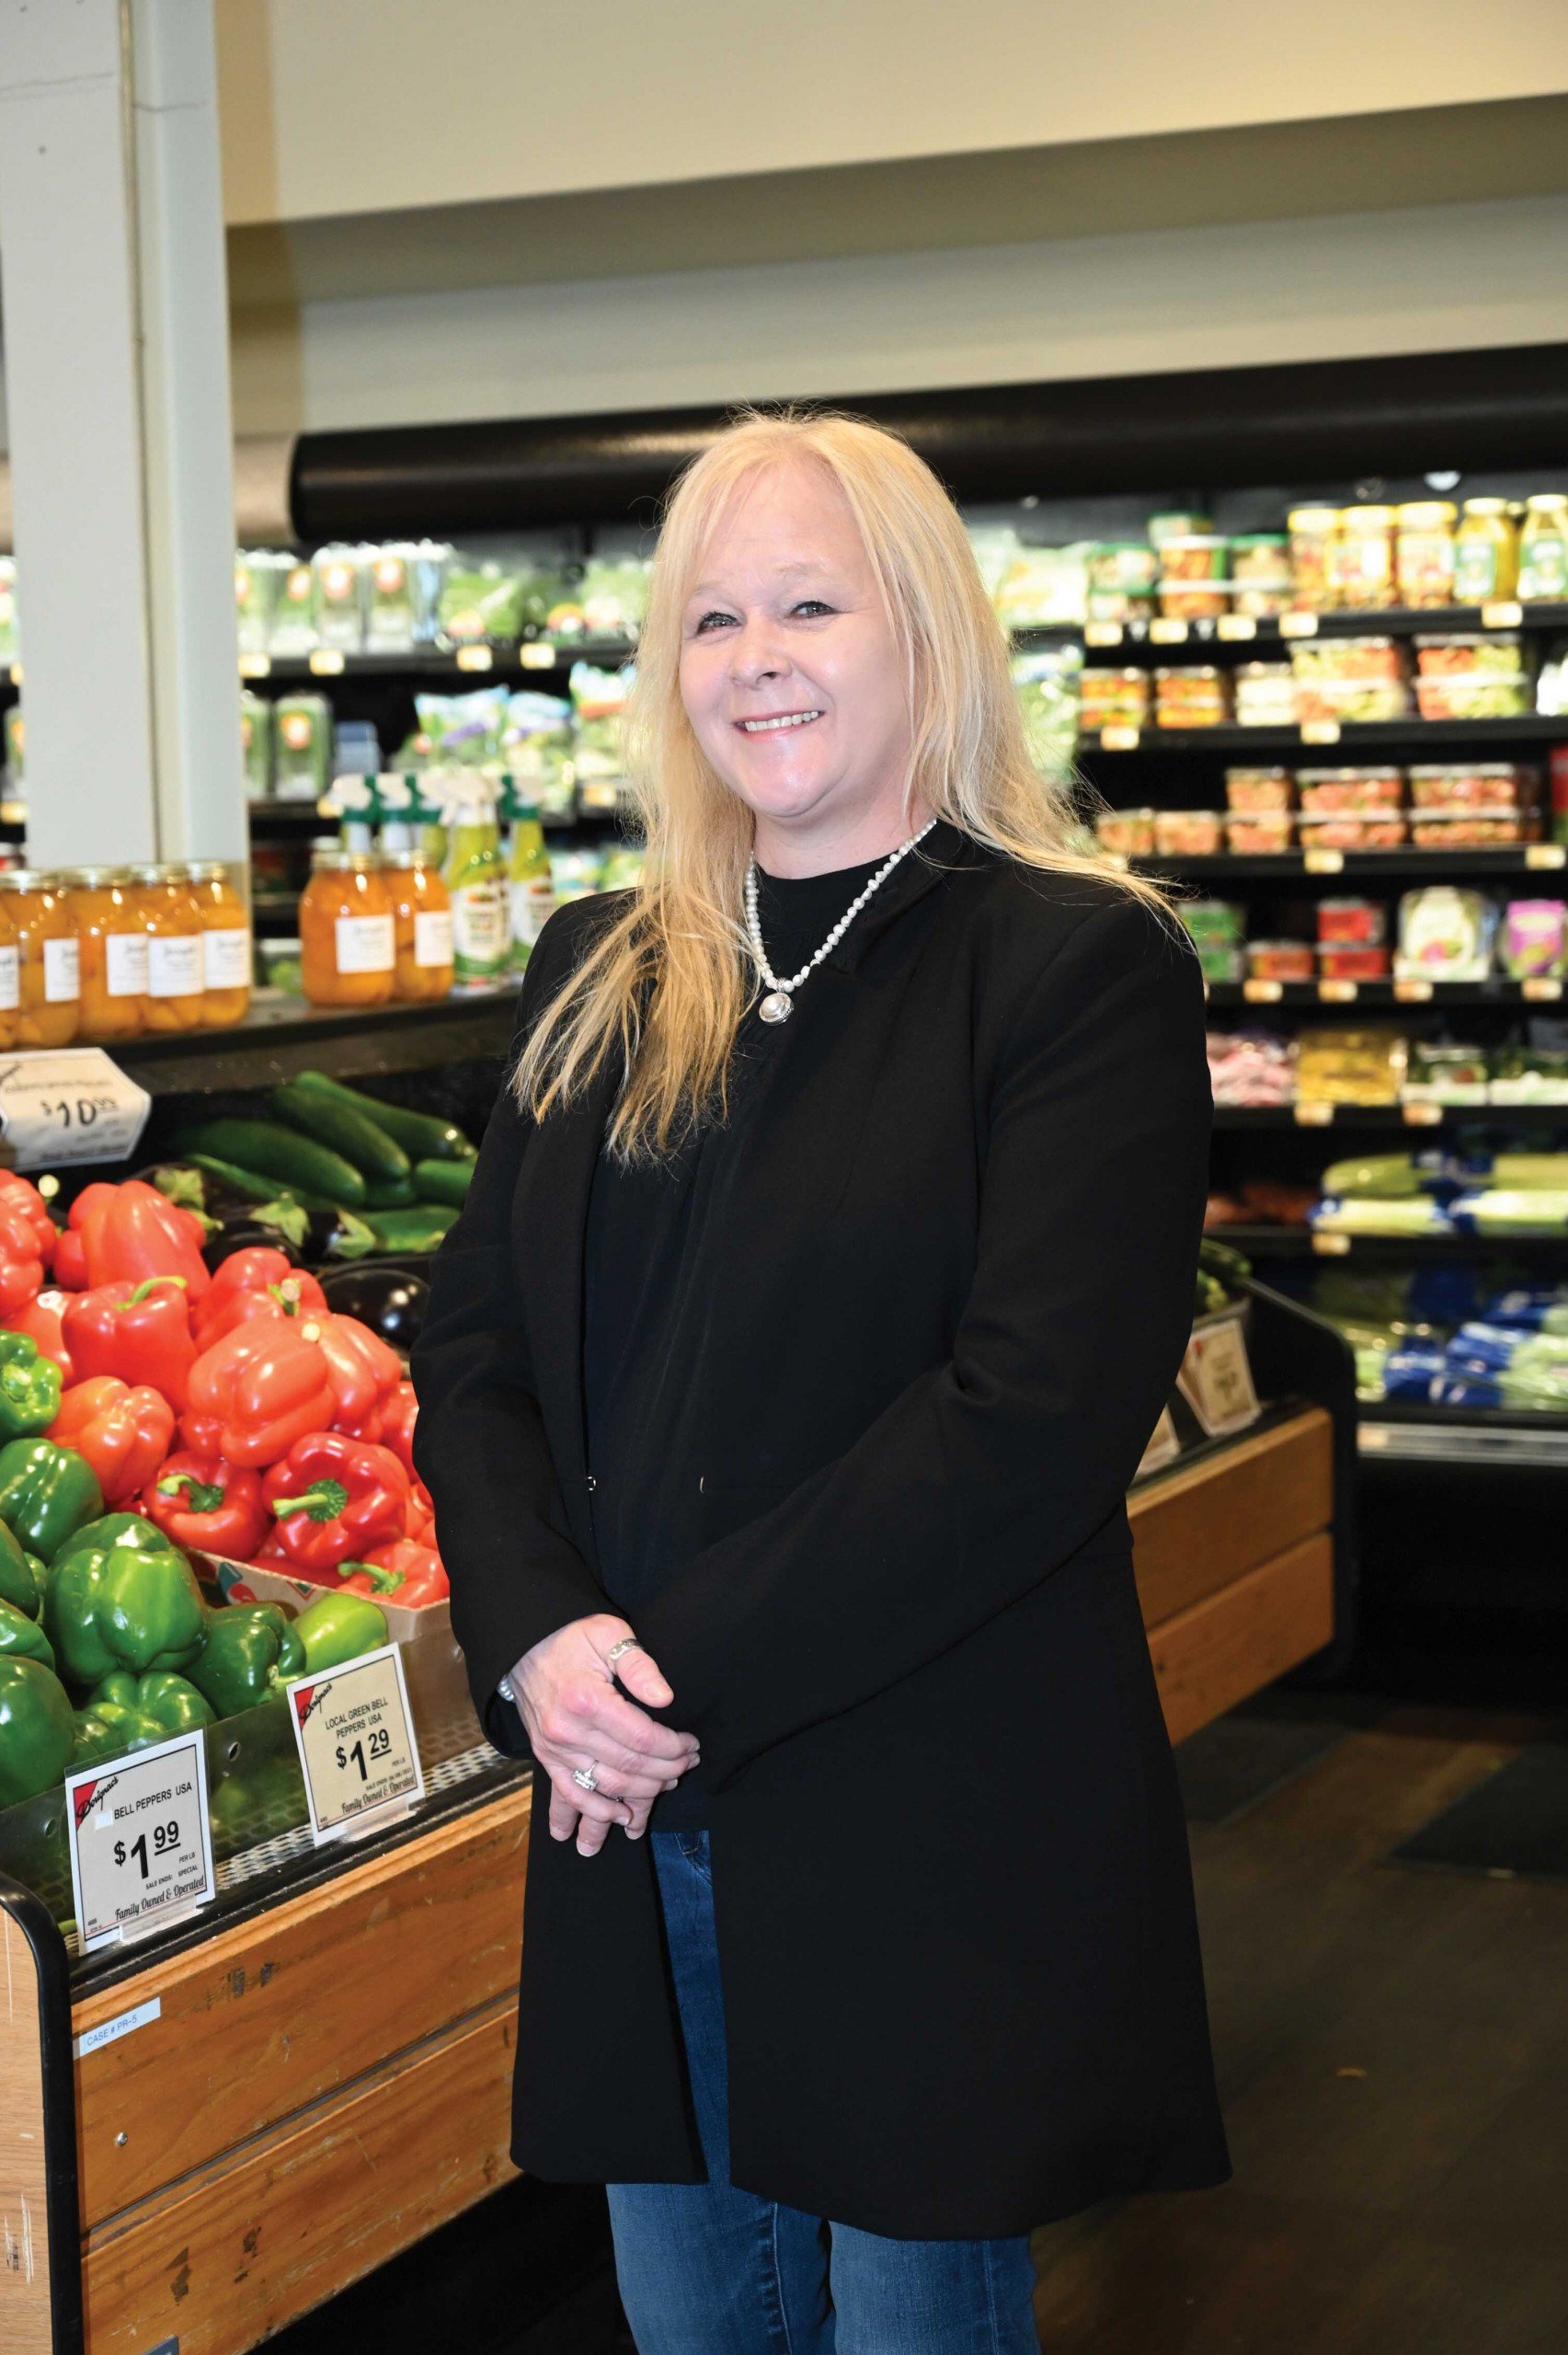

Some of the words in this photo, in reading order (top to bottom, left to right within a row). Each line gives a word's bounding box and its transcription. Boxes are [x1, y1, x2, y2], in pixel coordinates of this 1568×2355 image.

[325, 1714, 348, 1729] LOCAL
[349, 1704, 371, 1719] GREEN
[372, 1697, 388, 1711] BELL
[336, 1719, 366, 1739] PEPPERS
[368, 1713, 383, 1725] USA
[114, 1804, 135, 1820] BELL
[136, 1789, 172, 1811] PEPPERS
[176, 1782, 192, 1796] USA
[341, 1797, 362, 1814] Family
[178, 1854, 189, 1864] PER
[189, 1851, 196, 1860] LB
[145, 1879, 157, 1890] SALE
[177, 1865, 198, 1877] SPECIAL
[115, 1902, 140, 1920] Family
[141, 1891, 165, 1909] Owned
[166, 1888, 172, 1900] &
[173, 1875, 204, 1897] Operated
[86, 2028, 109, 2046] CASE
[117, 2015, 138, 2030] PR-5
